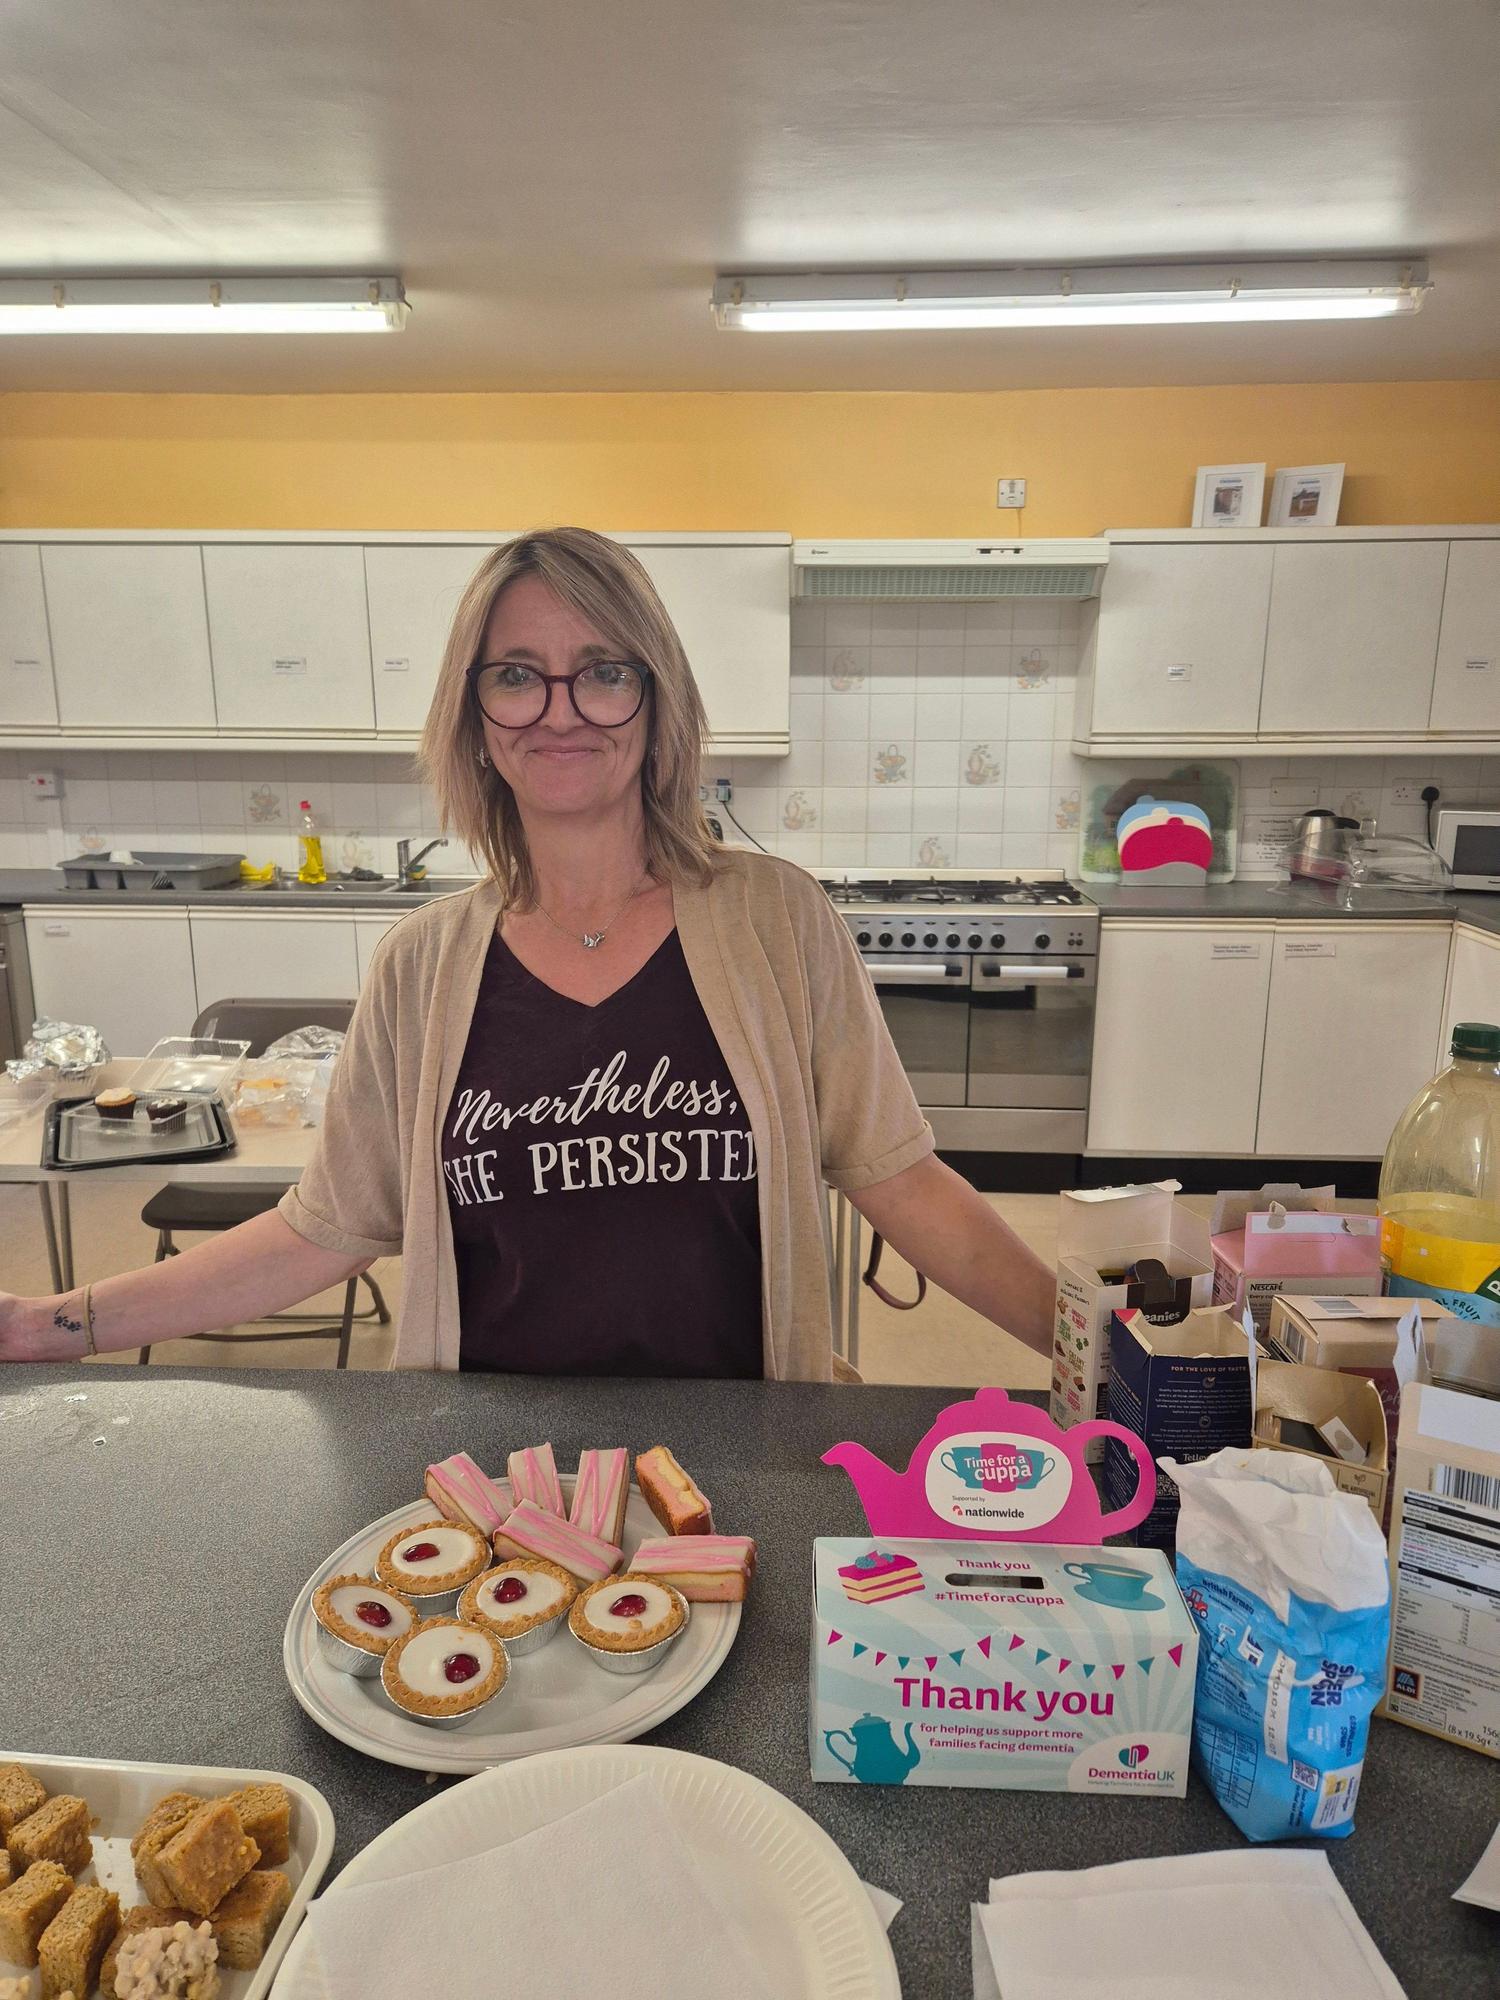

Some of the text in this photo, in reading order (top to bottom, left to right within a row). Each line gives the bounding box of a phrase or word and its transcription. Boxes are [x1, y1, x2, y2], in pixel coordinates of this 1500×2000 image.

[452, 1050, 737, 1145] Nevertheless,
[443, 1150, 504, 1207] SHE
[1250, 1281, 1284, 1291] NESCAFÉ
[1143, 1311, 1181, 1322] eanies
[1452, 1299, 1481, 1321] FRUIT
[963, 1454, 1027, 1469] Time for a
[974, 1464, 1032, 1483] cuppa
[965, 1507, 1025, 1519] nationwide
[956, 1559, 1031, 1571] Thank you
[934, 1591, 1065, 1607] #TimeforaCuppa
[1396, 1682, 1416, 1695] ALDI
[894, 1677, 1114, 1722] Thank you
[920, 1723, 1084, 1740] for helping us support more
[928, 1738, 1075, 1754] families facing dementia
